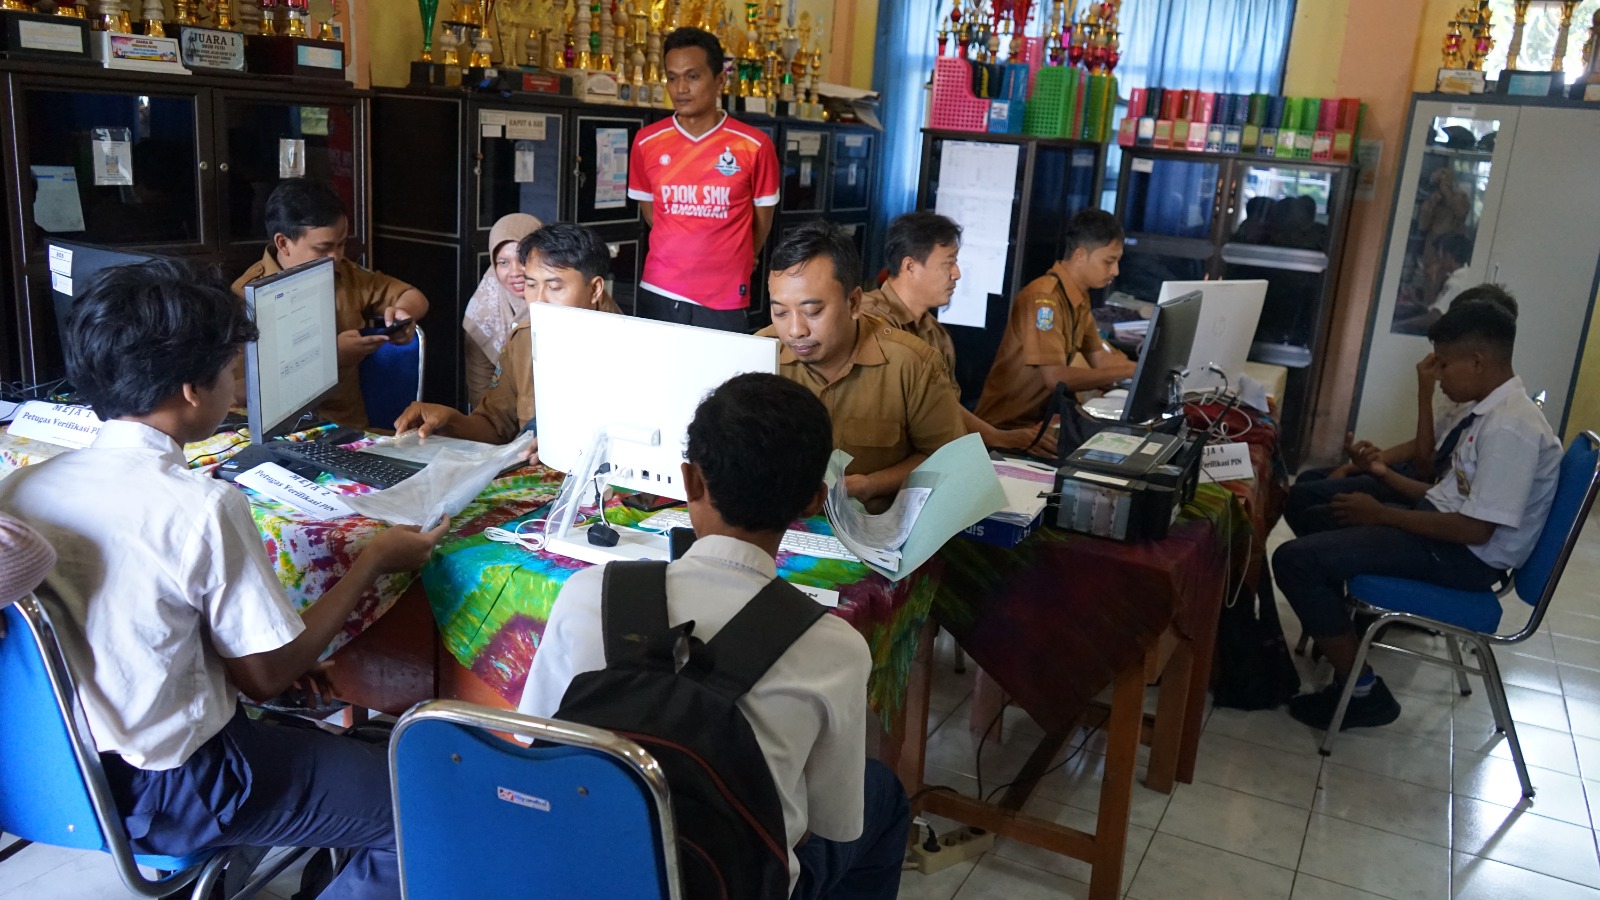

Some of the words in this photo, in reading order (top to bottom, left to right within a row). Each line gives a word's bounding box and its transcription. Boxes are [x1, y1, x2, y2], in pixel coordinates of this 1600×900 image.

[193, 33, 227, 45] JUARA
[231, 38, 235, 46] I
[661, 185, 698, 204] PJOK
[702, 185, 731, 206] SMK
[52, 404, 82, 416] MEJA
[22, 411, 51, 424] Petugas
[52, 417, 90, 433] Verifikasi
[90, 427, 101, 435] PI
[1230, 458, 1242, 466] PIN
[254, 469, 284, 487] Petugas
[283, 484, 323, 506] Verifikasi
[319, 503, 338, 512] PIN
[289, 474, 321, 491] MEJA
